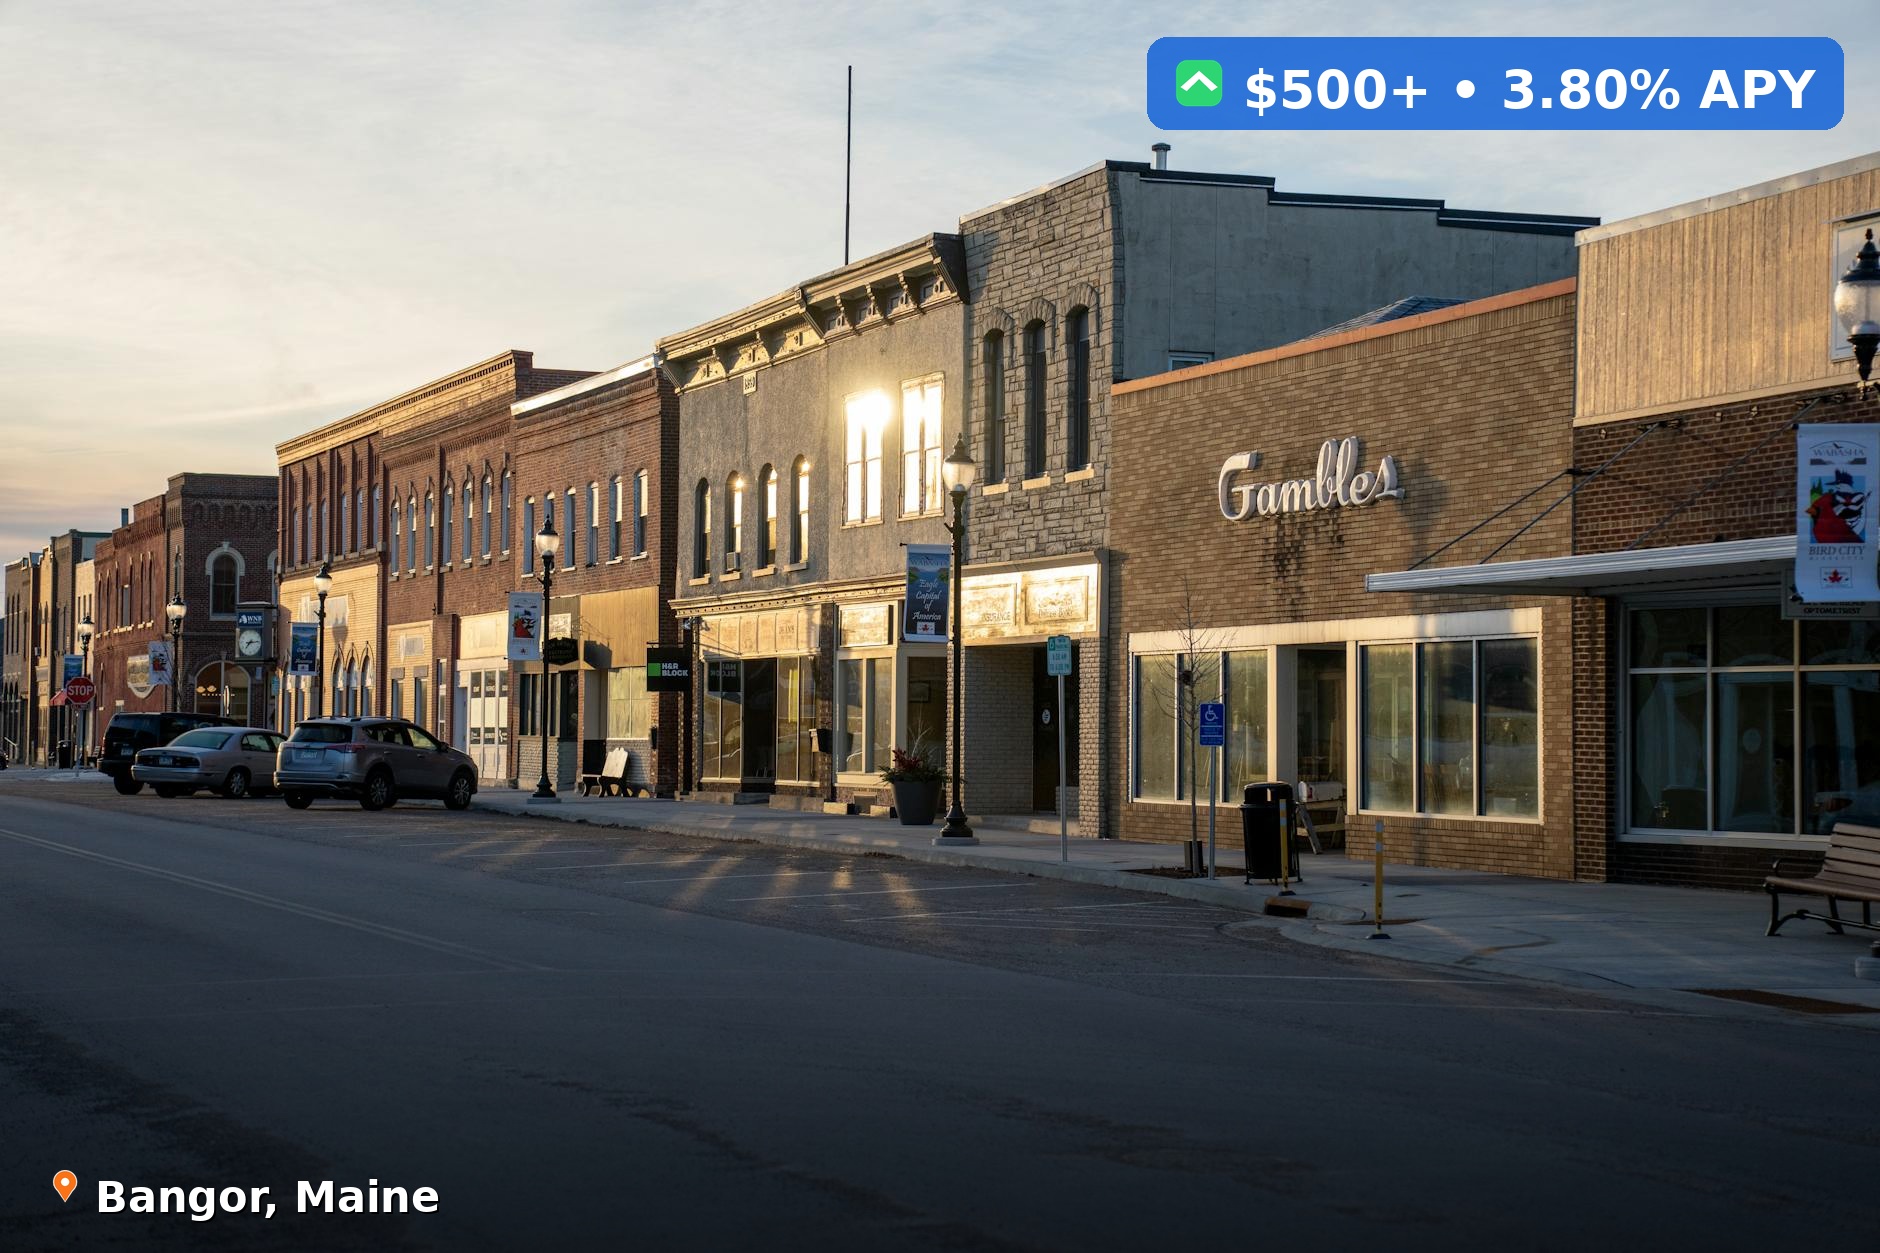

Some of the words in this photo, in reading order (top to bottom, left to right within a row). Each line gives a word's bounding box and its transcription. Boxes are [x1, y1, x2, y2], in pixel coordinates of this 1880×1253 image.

[1812, 448, 1865, 457] WABASHA
[1218, 435, 1405, 521] Gambles
[1809, 546, 1836, 556] BIRD
[1839, 545, 1866, 556] CITY
[919, 579, 938, 593] Eagle
[916, 590, 942, 604] Capital
[924, 600, 934, 612] of
[1803, 607, 1862, 615] OPTOMETRIST
[912, 611, 942, 621] America
[662, 669, 688, 677] BLOCK
[68, 685, 93, 696] STOP
